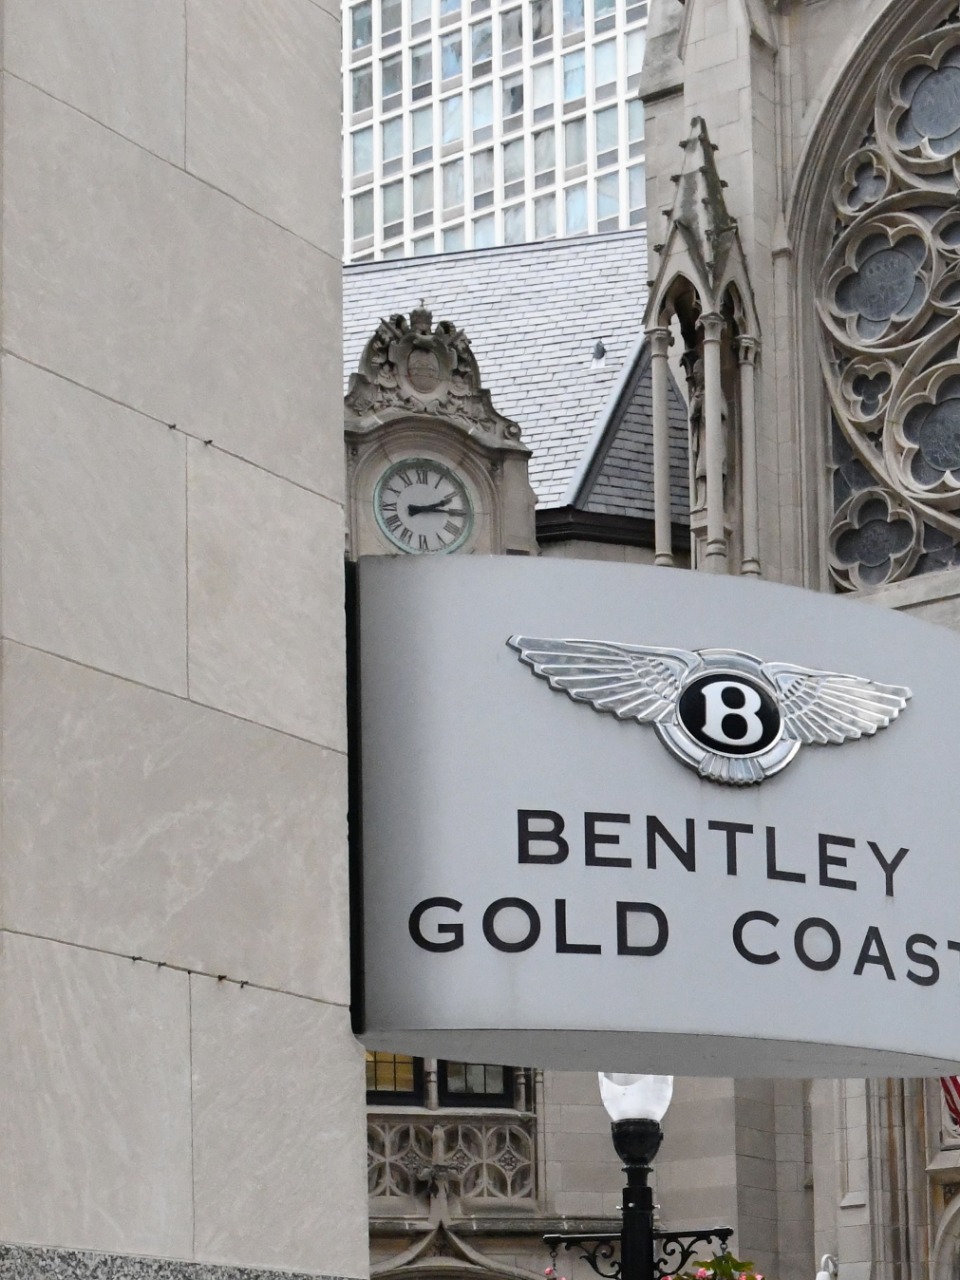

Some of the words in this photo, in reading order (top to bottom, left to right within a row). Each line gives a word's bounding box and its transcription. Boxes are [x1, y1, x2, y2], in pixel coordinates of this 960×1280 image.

[382, 502, 397, 511] IX
[416, 469, 428, 485] XII
[700, 681, 764, 747] B
[517, 808, 910, 897] BENTLEY
[408, 896, 670, 956] GOLD
